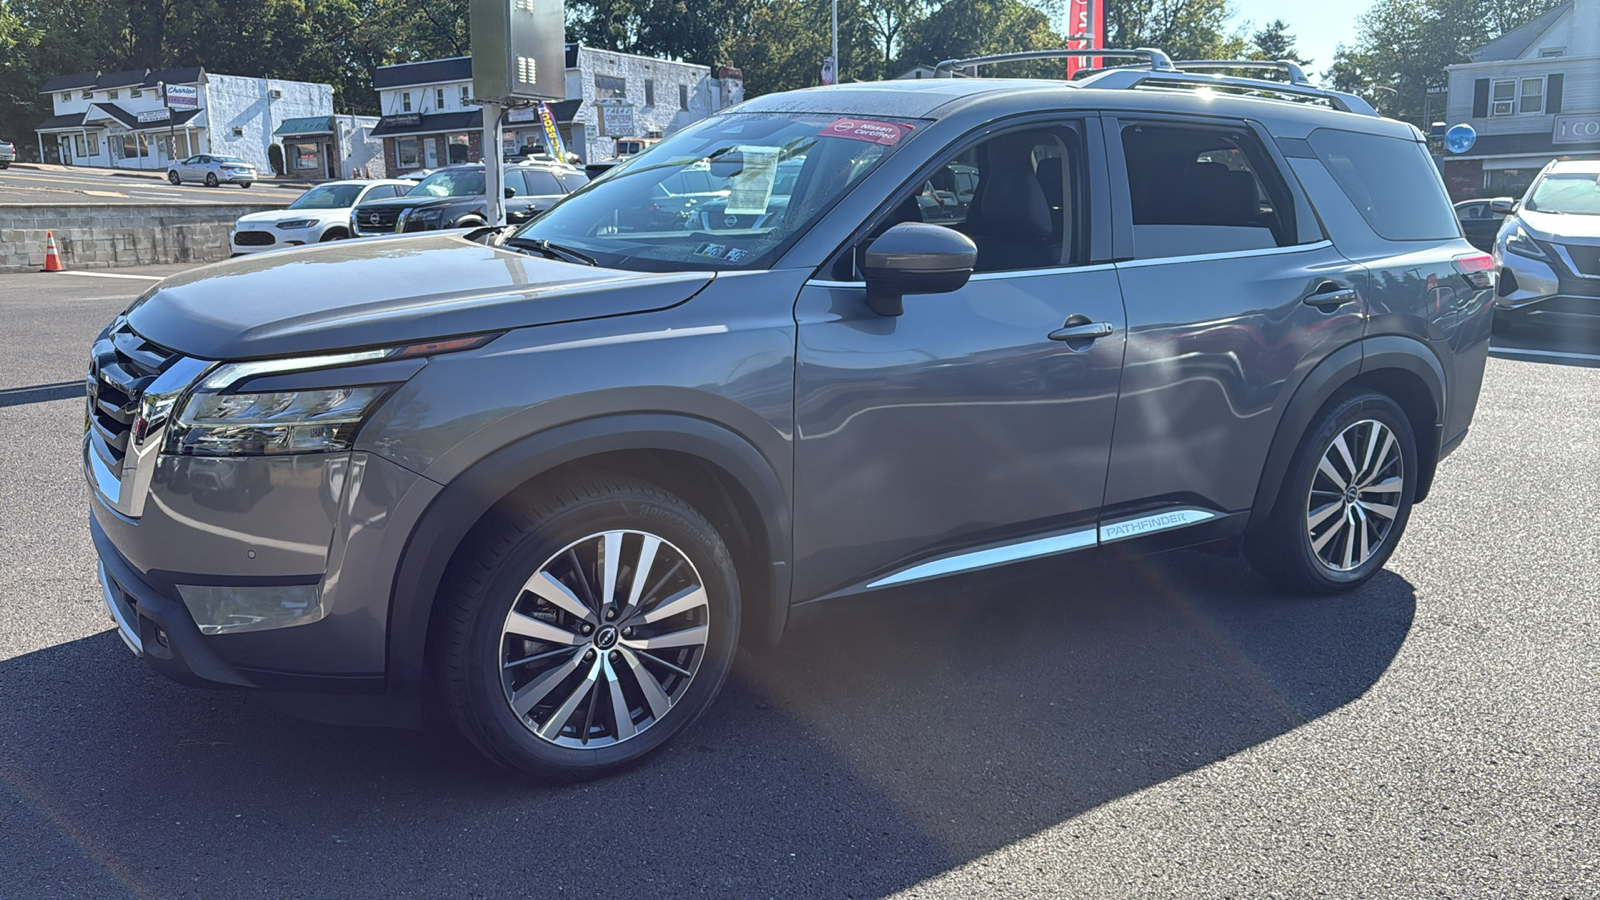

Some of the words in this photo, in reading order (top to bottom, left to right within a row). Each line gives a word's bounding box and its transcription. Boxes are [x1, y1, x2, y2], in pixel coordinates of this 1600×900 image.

[860, 123, 893, 133] Nissan
[854, 129, 895, 140] Certified
[1106, 513, 1187, 537] PATHFINDER
